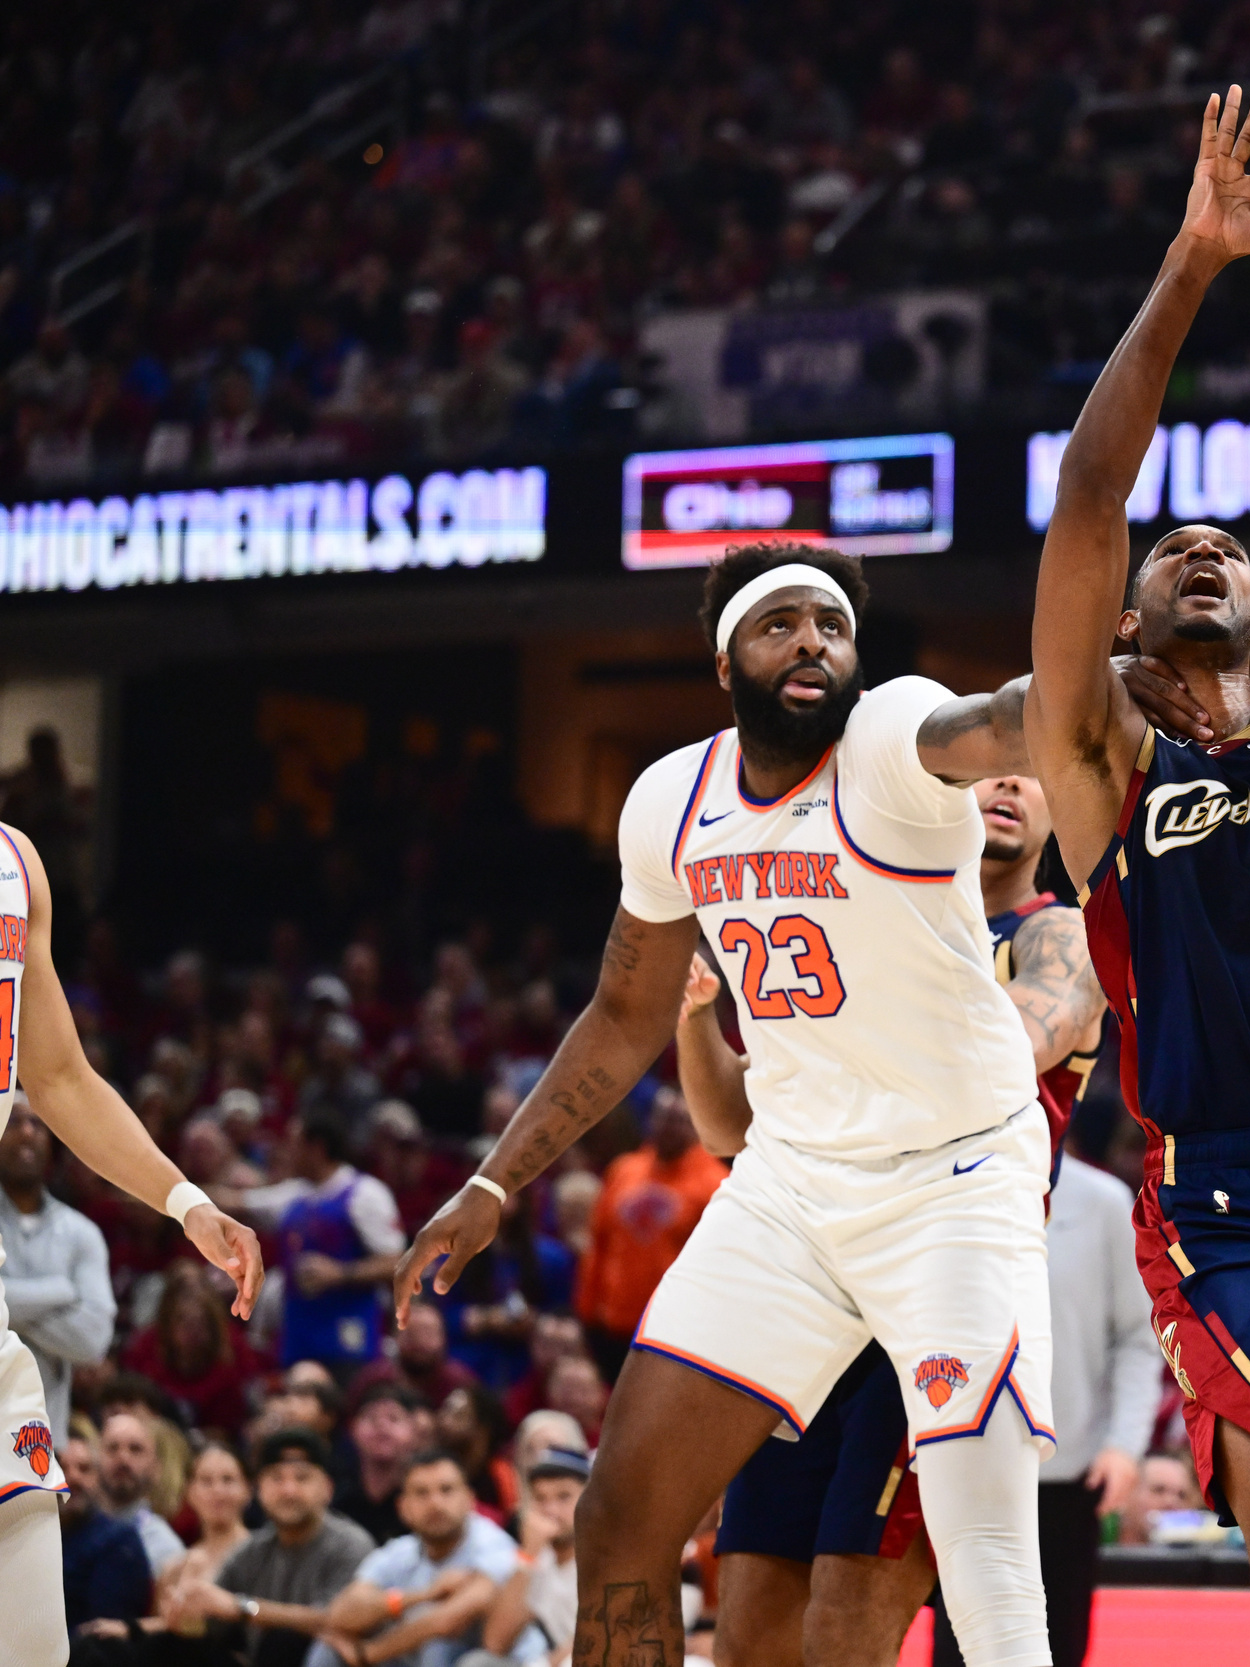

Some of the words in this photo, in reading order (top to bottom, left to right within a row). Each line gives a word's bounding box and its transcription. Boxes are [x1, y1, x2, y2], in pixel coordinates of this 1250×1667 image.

[684, 853, 744, 909] NEW
[746, 850, 849, 900] YORK
[718, 913, 848, 1020] 23
[914, 1356, 970, 1388] KNICKS
